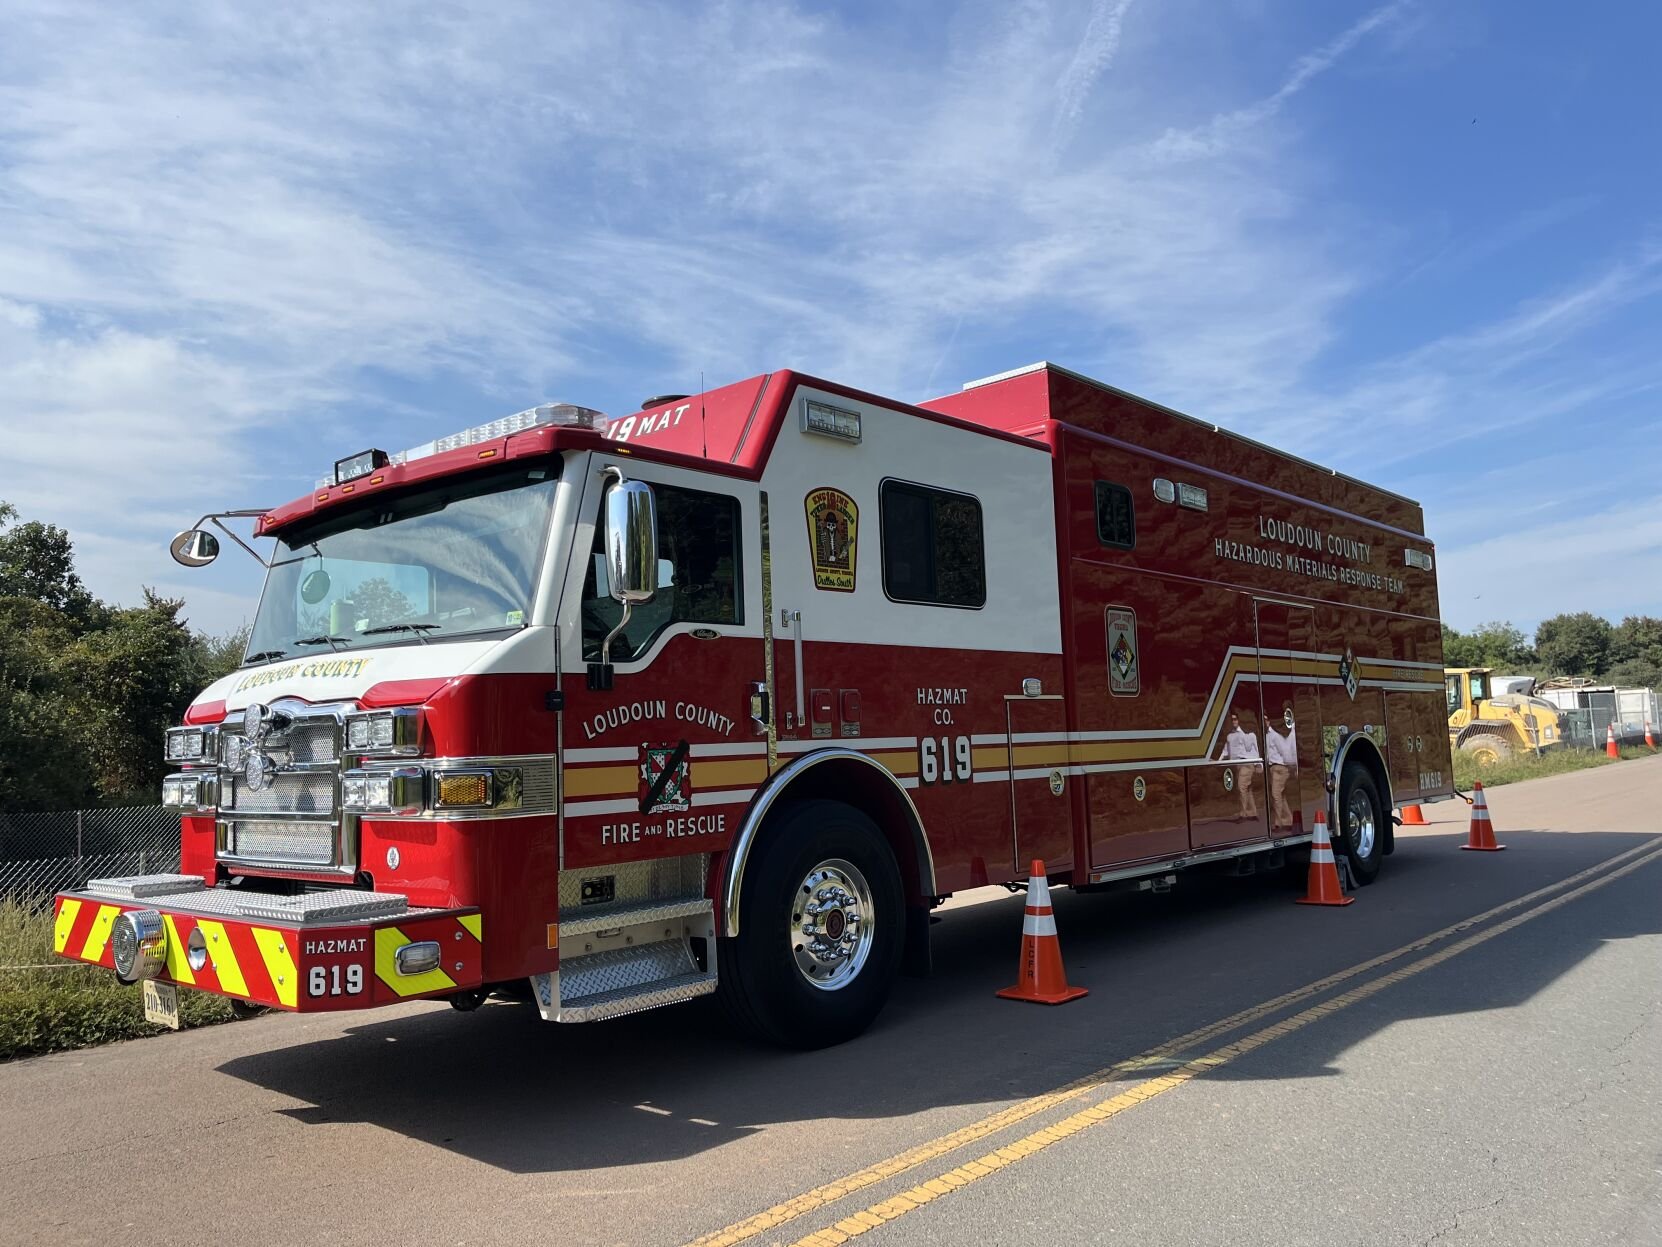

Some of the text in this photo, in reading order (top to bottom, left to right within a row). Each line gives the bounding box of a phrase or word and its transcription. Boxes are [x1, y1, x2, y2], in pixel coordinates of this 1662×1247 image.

[635, 404, 690, 437] MAT
[1259, 515, 1371, 563] LOUDOUN COUNTY
[1215, 538, 1404, 594] HAZARDOUS MATERIALS RESPONSE TEAM
[301, 657, 373, 679] COUNTY
[917, 688, 968, 704] HAZMAT
[582, 700, 735, 740] LOUDOUN COUNTY
[934, 709, 954, 725] CO.
[921, 736, 972, 782] 619
[602, 814, 726, 845] FIRE AND RESCUE
[306, 939, 367, 954] HAZMAT
[309, 964, 363, 996] 619
